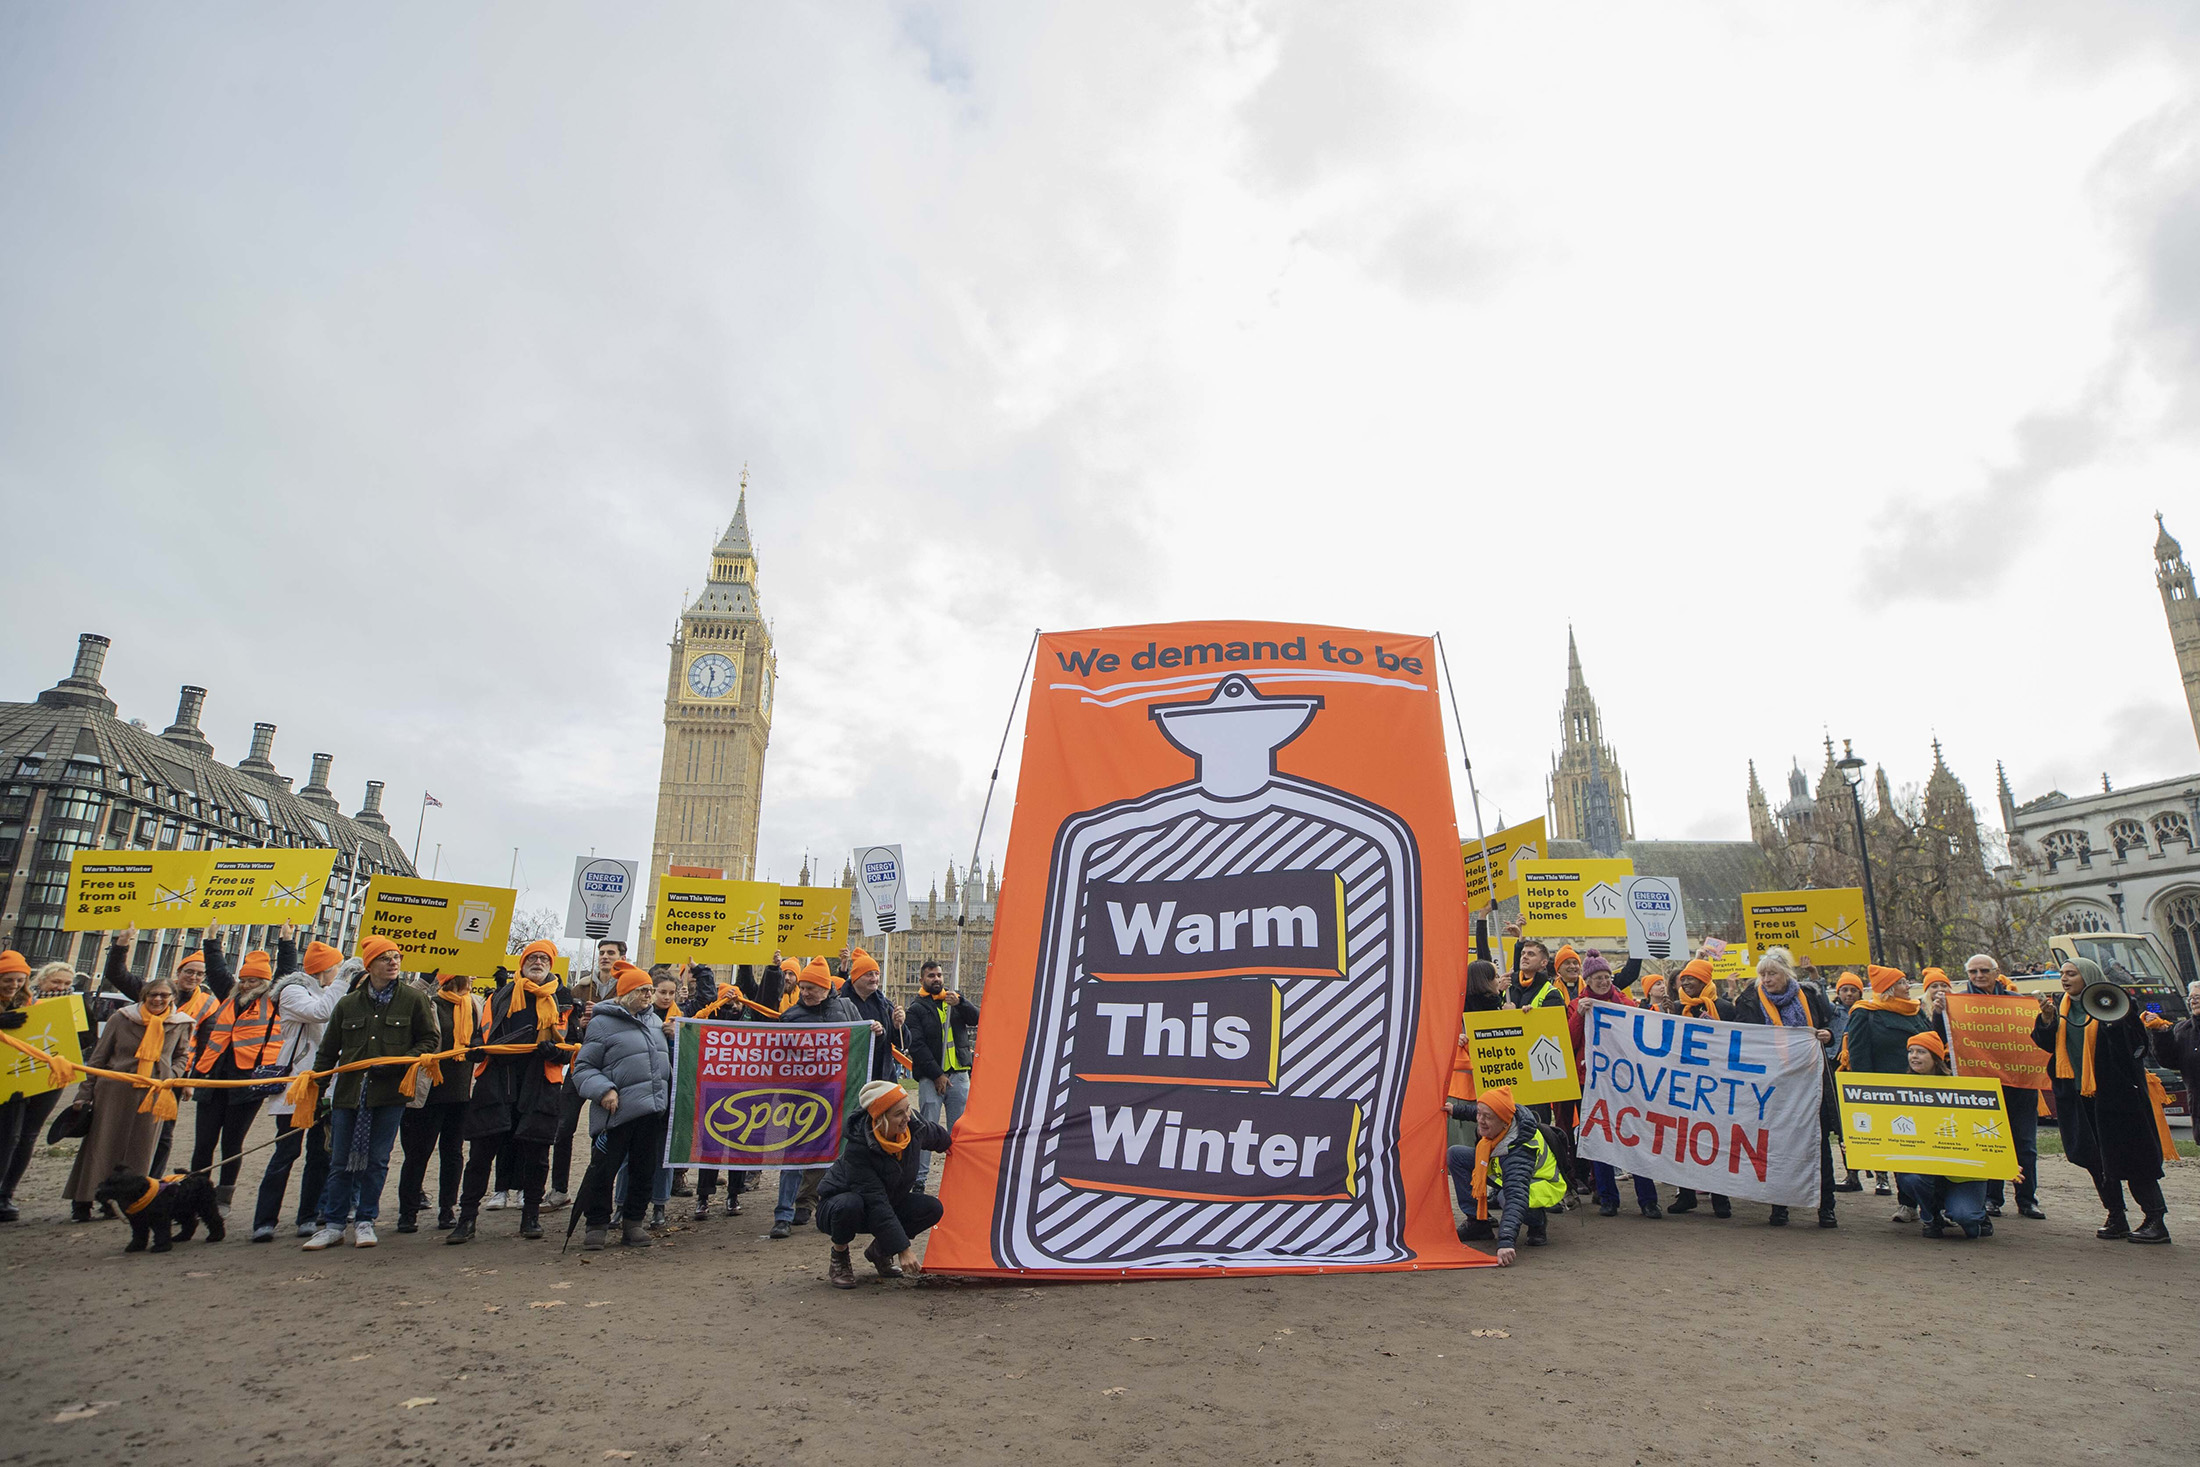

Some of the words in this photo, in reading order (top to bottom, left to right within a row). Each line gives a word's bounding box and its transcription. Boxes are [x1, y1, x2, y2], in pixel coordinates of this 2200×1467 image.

[1056, 648, 1120, 678] We
[1131, 636, 1307, 668] demand
[1319, 640, 1362, 665] to
[1375, 646, 1424, 675] be
[867, 862, 893, 872] ENERGY
[1466, 865, 1486, 878] Help
[81, 880, 115, 888] Free
[209, 876, 238, 884] Free
[588, 873, 622, 882] ENERGY
[1466, 869, 1503, 888] upgrde
[79, 892, 115, 900] from
[118, 891, 136, 900] oil
[205, 887, 234, 896] from
[237, 887, 254, 896] oil
[1527, 888, 1554, 898] Help
[1557, 888, 1569, 896] to
[200, 899, 210, 907] &
[212, 900, 236, 909] gas
[380, 893, 403, 902] Warm
[420, 898, 446, 906] Winter
[1528, 899, 1576, 910] upgrade
[78, 904, 89, 913] &
[94, 905, 121, 915] gas
[667, 908, 711, 919] Access
[714, 910, 726, 920] to
[1529, 911, 1568, 920] homes
[374, 910, 412, 923] More
[666, 921, 716, 933] cheaper
[1106, 900, 1318, 956] Warm
[1754, 920, 1779, 928] Free
[371, 925, 437, 940] targeted
[1785, 930, 1800, 938] oil
[665, 936, 708, 947] energy
[1756, 942, 1765, 951] &
[397, 944, 427, 960] port
[429, 946, 459, 956] now
[1964, 1004, 2012, 1016] London
[2016, 1006, 2042, 1019] Reg
[1096, 1002, 1250, 1060] This
[1951, 1020, 2004, 1032] National
[2008, 1023, 2033, 1034] Pen
[706, 1032, 845, 1046] SOUTHWARK
[1593, 1006, 1766, 1074] FUEL
[704, 1048, 843, 1062] PENSIONERS
[1477, 1046, 1503, 1059] Help
[1505, 1046, 1516, 1056] to
[702, 1063, 773, 1076] ACTION
[779, 1064, 842, 1076] GROUP
[1480, 1059, 1524, 1075] upgrade
[1958, 1057, 1987, 1067] here
[1989, 1060, 2001, 1069] to
[2004, 1063, 2047, 1074] suppor
[1482, 1076, 1518, 1088] homes
[1590, 1051, 1776, 1120] POVERTY
[1845, 1087, 1895, 1102] Warm
[1897, 1091, 1934, 1104] This
[1936, 1092, 1996, 1106] Winter
[713, 1095, 819, 1144] Spag
[1089, 1105, 1332, 1178] Winter
[1580, 1098, 1769, 1182] ACTION
